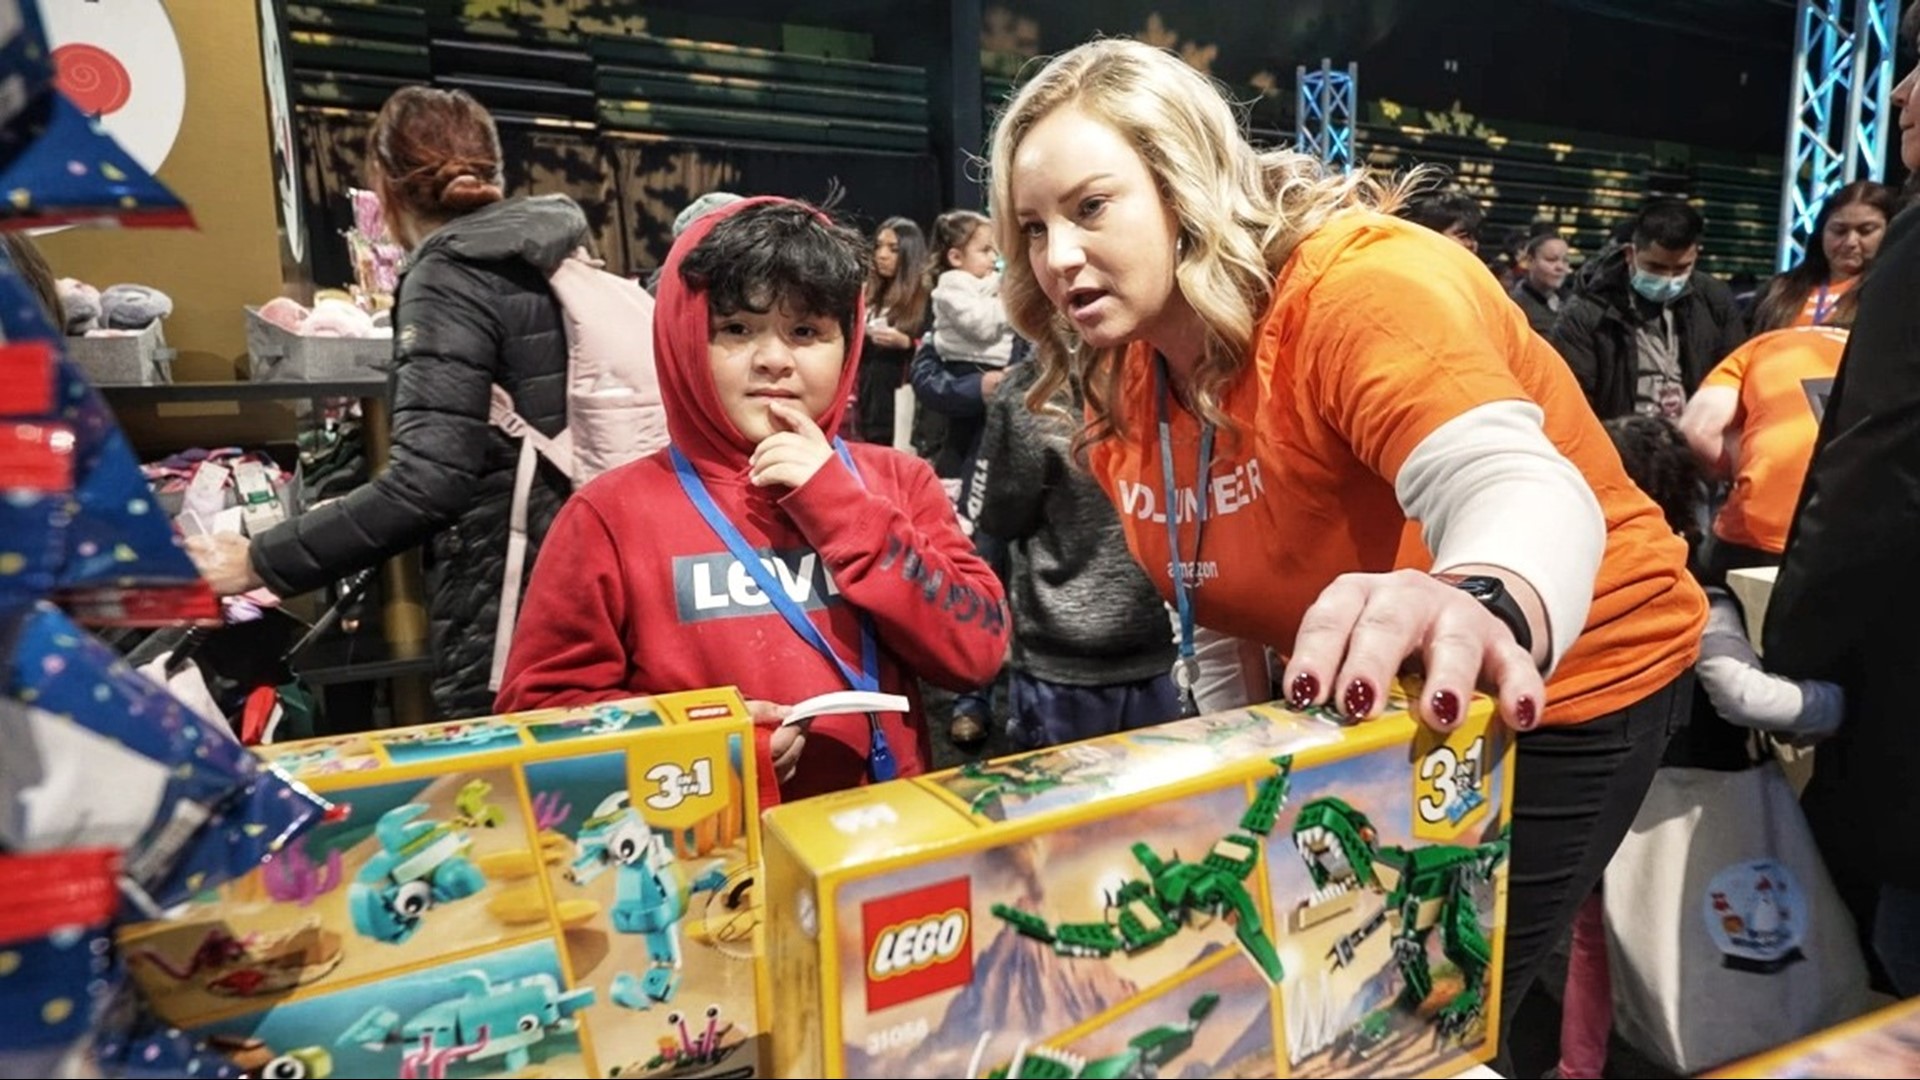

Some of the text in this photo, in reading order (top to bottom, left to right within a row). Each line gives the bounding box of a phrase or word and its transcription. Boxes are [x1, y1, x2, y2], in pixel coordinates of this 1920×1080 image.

[1118, 458, 1265, 524] VOLUNEER
[1167, 561, 1219, 578] amazon
[872, 911, 967, 977] LEGO
